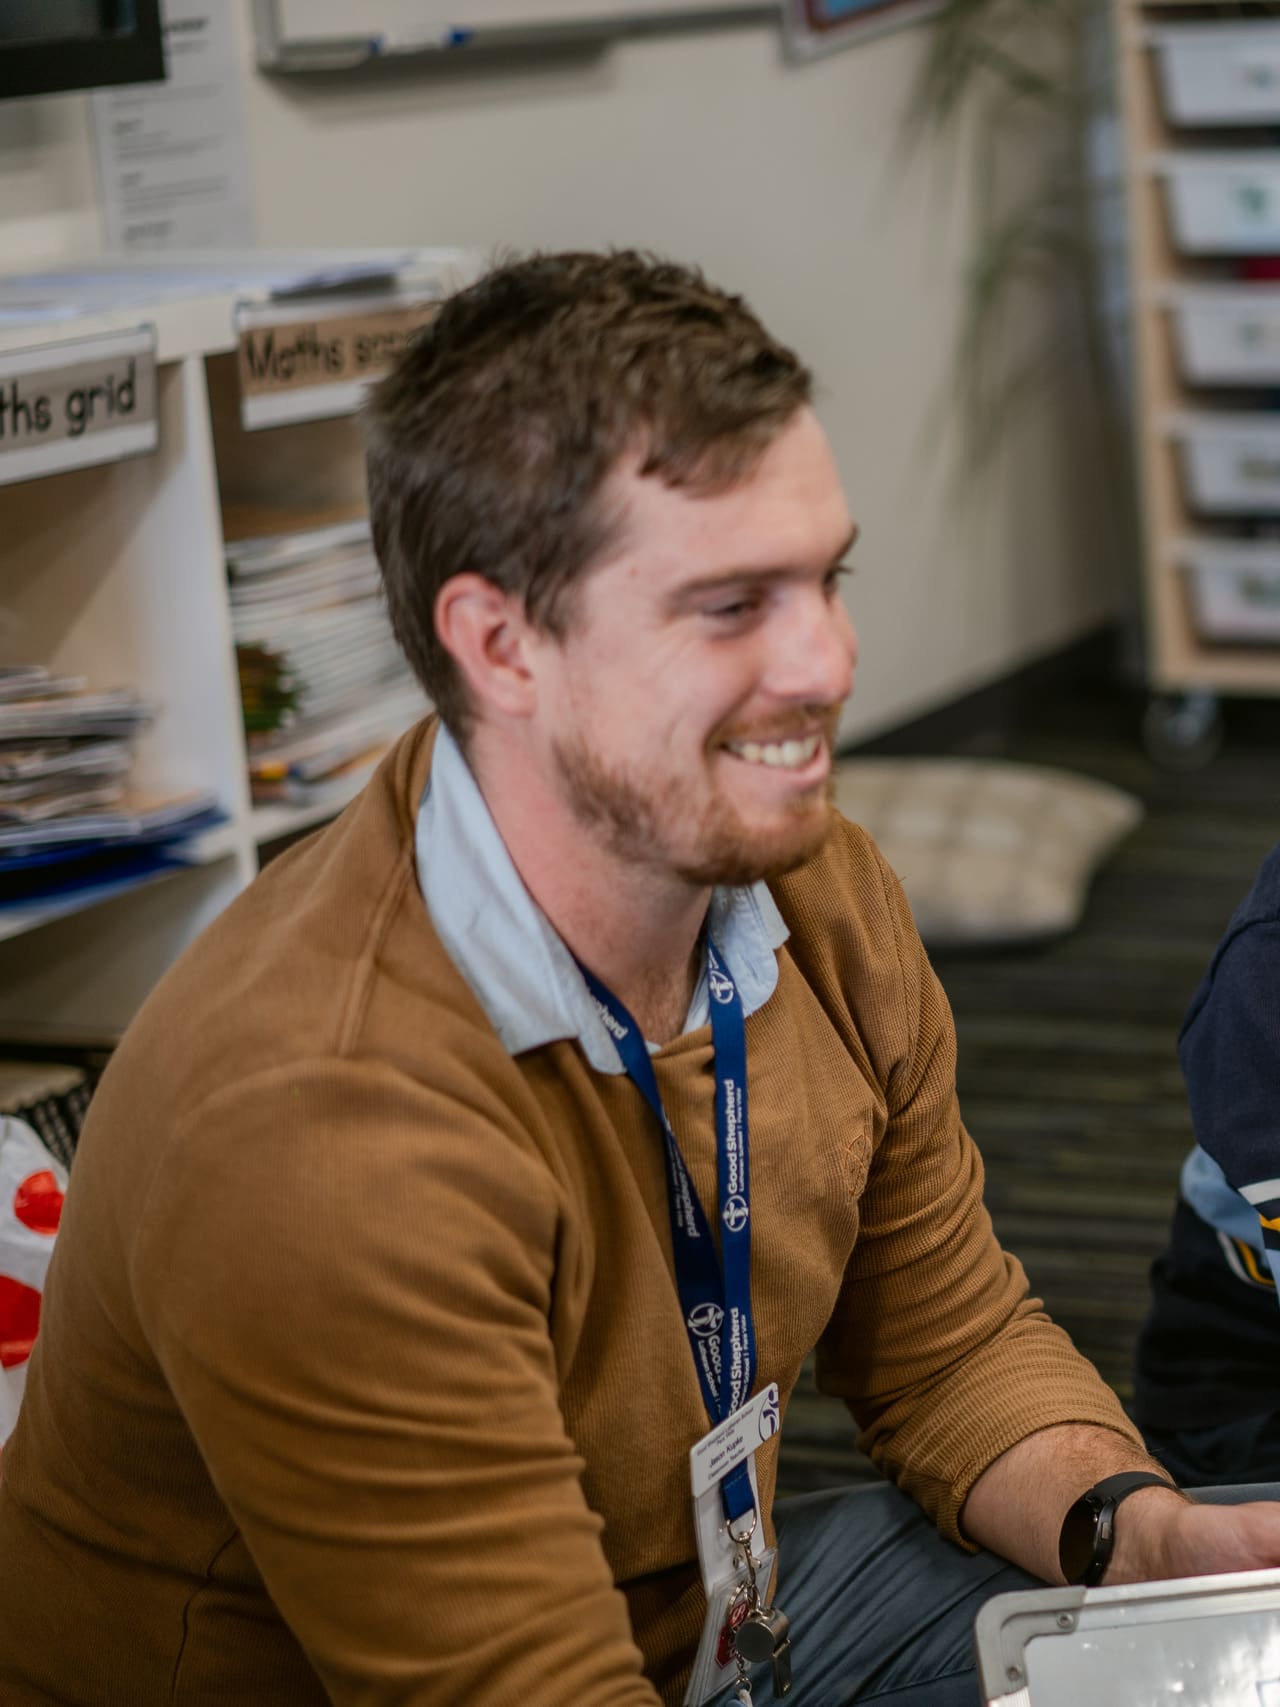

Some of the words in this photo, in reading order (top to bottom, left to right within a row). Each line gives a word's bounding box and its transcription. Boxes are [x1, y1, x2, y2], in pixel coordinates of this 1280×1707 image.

[246, 322, 344, 380] Maths
[0, 378, 52, 440] ths
[66, 356, 136, 440] grid
[724, 1079, 737, 1152] Shepherd
[727, 1152, 738, 1194] Good
[730, 1307, 743, 1380] Shepherd
